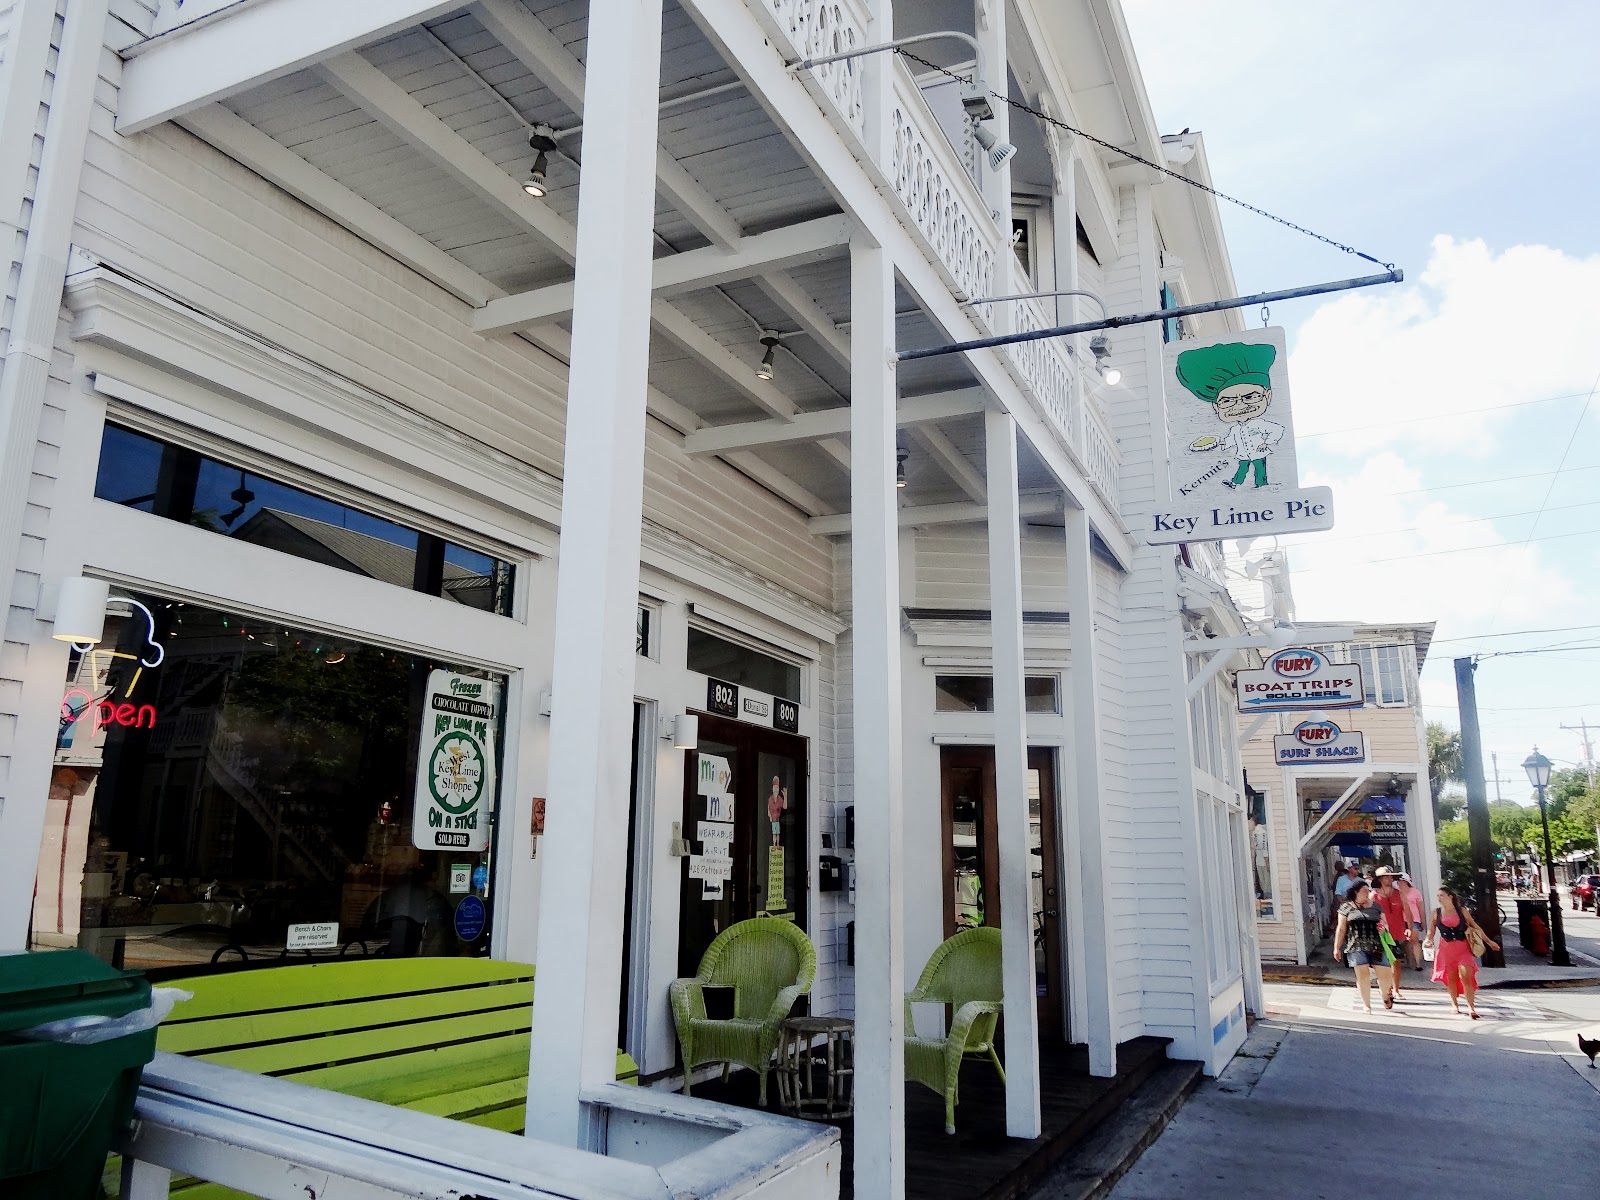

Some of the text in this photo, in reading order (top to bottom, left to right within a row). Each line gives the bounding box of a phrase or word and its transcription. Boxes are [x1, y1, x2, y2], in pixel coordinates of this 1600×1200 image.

[1178, 459, 1229, 496] Kermit's
[1152, 499, 1326, 534] Key Lime Pie
[1275, 657, 1314, 673] FURY
[450, 677, 482, 696] Frozen
[1244, 678, 1353, 693] BOAT TRIPS
[715, 684, 733, 706] 802
[1305, 690, 1341, 698] HERE
[62, 688, 156, 737] Open
[434, 696, 469, 713] CHOCOLATE
[780, 703, 794, 721] 800
[434, 713, 487, 747] KEY LIME PIE
[1298, 727, 1334, 741] FURY
[449, 750, 471, 766] West
[1280, 746, 1359, 759] SURF SHACK
[438, 761, 479, 777] Key Lime
[441, 777, 472, 793] Shoppe
[428, 806, 478, 830] ON A STICK
[438, 833, 467, 845] SOLD HERE
